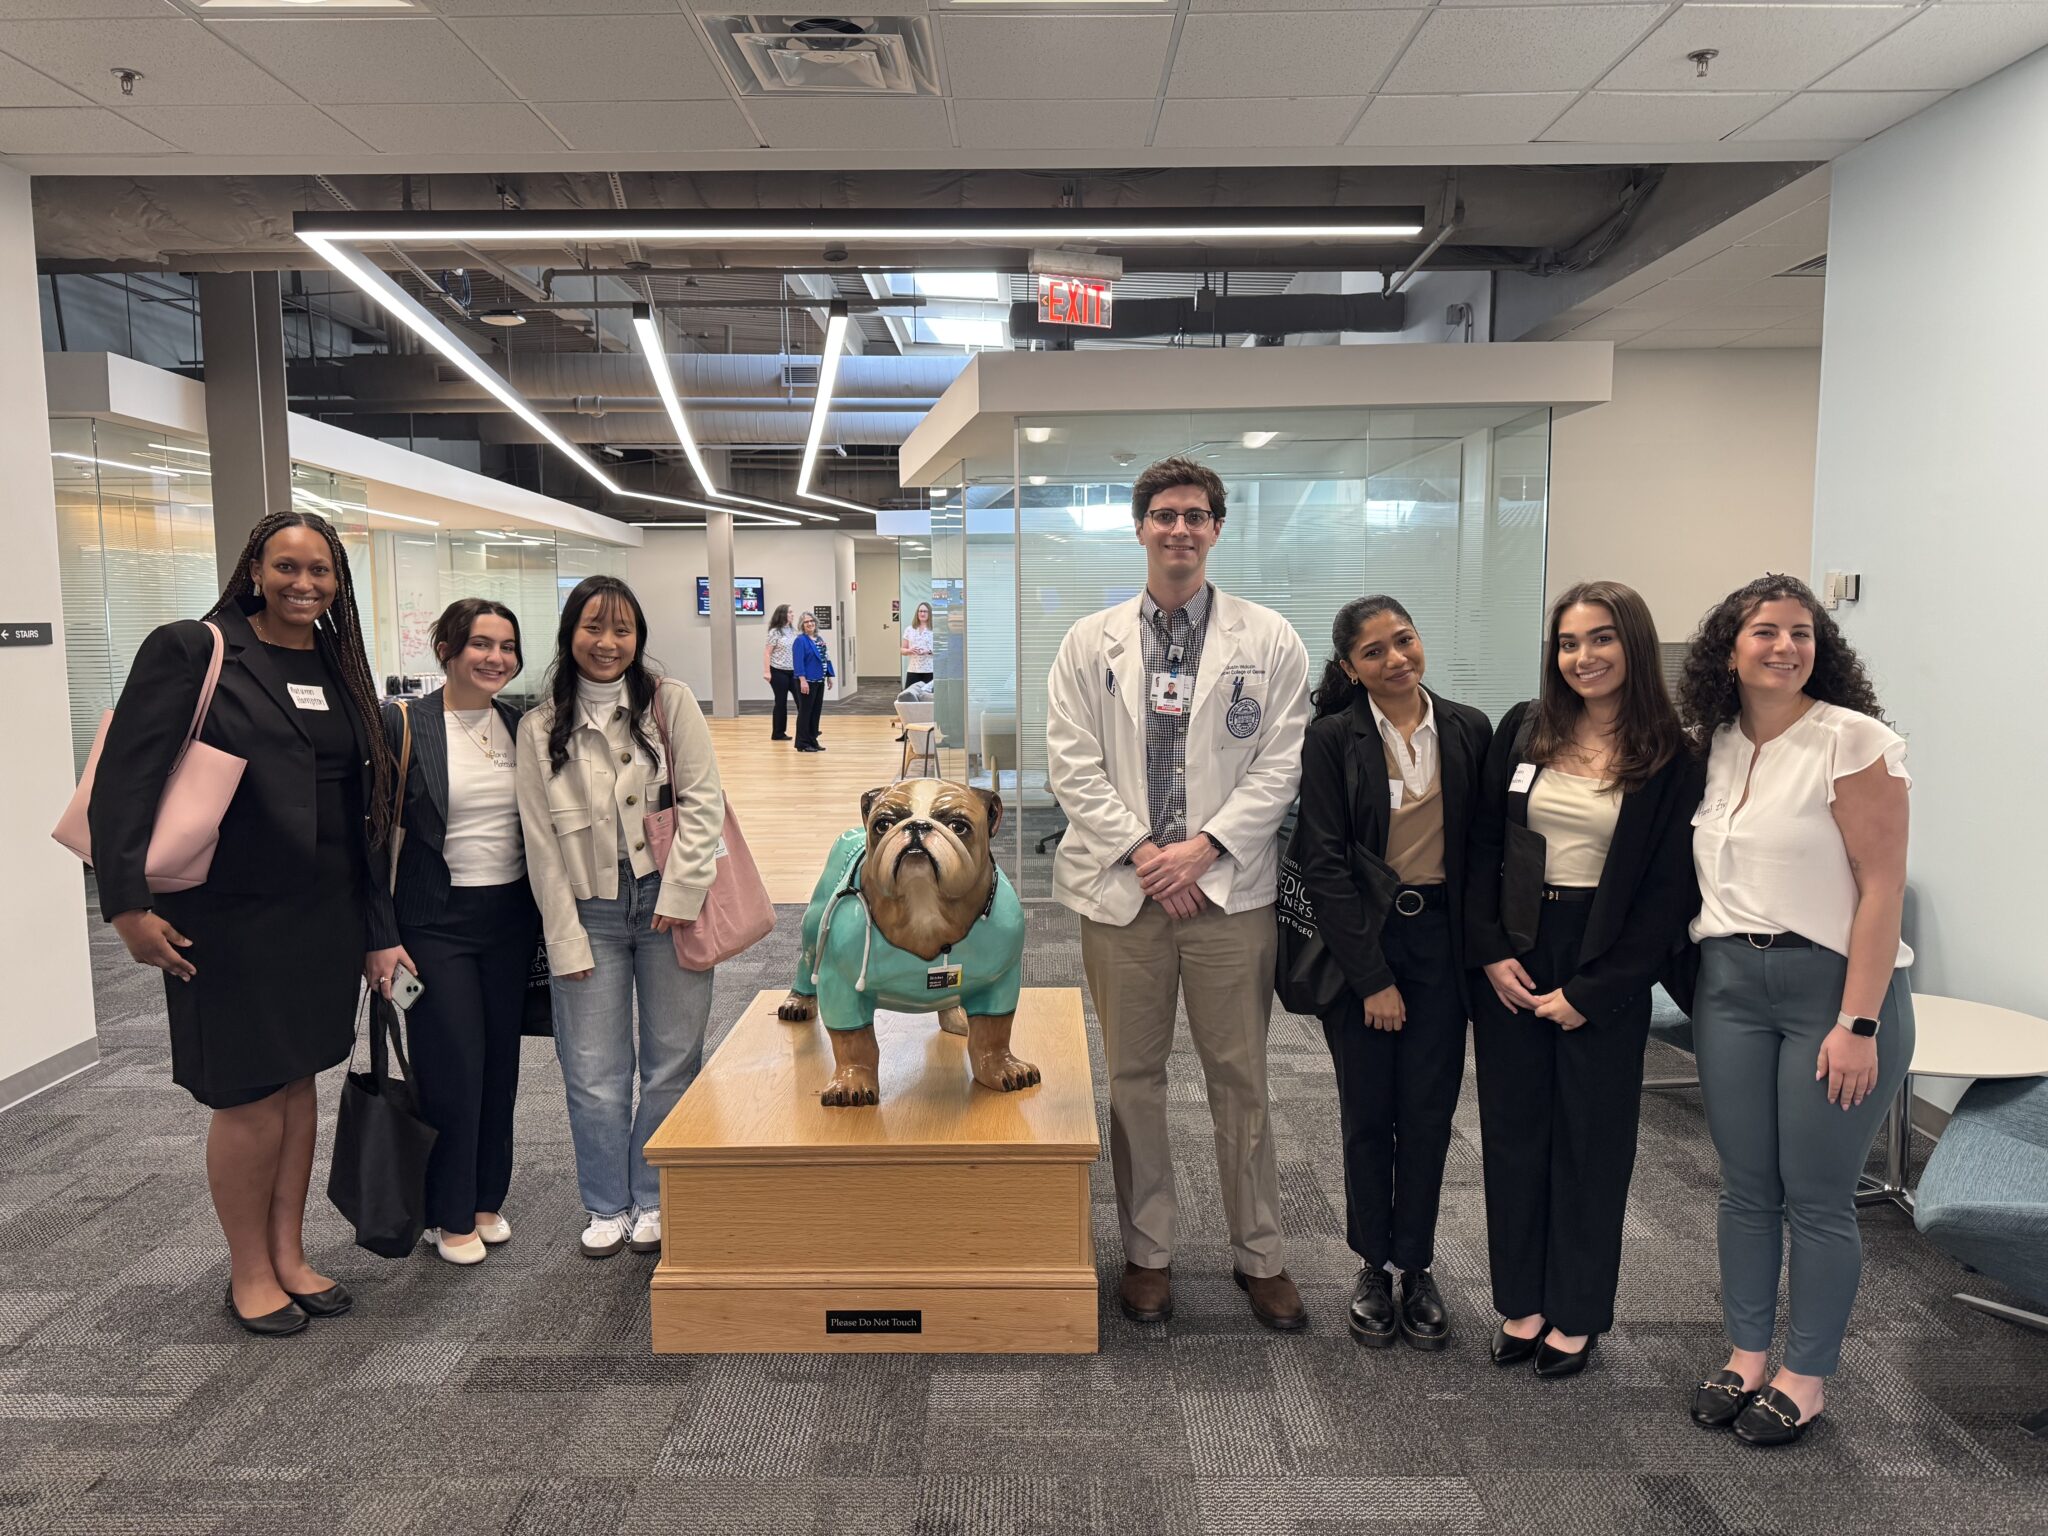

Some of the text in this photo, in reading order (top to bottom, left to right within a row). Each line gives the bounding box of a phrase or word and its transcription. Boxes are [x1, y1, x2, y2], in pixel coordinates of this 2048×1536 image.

[1048, 281, 1105, 326] EXIT
[15, 629, 39, 639] STAIRS
[1279, 868, 1312, 905] EDIC
[830, 1318, 917, 1327] Please Do Not Touch
